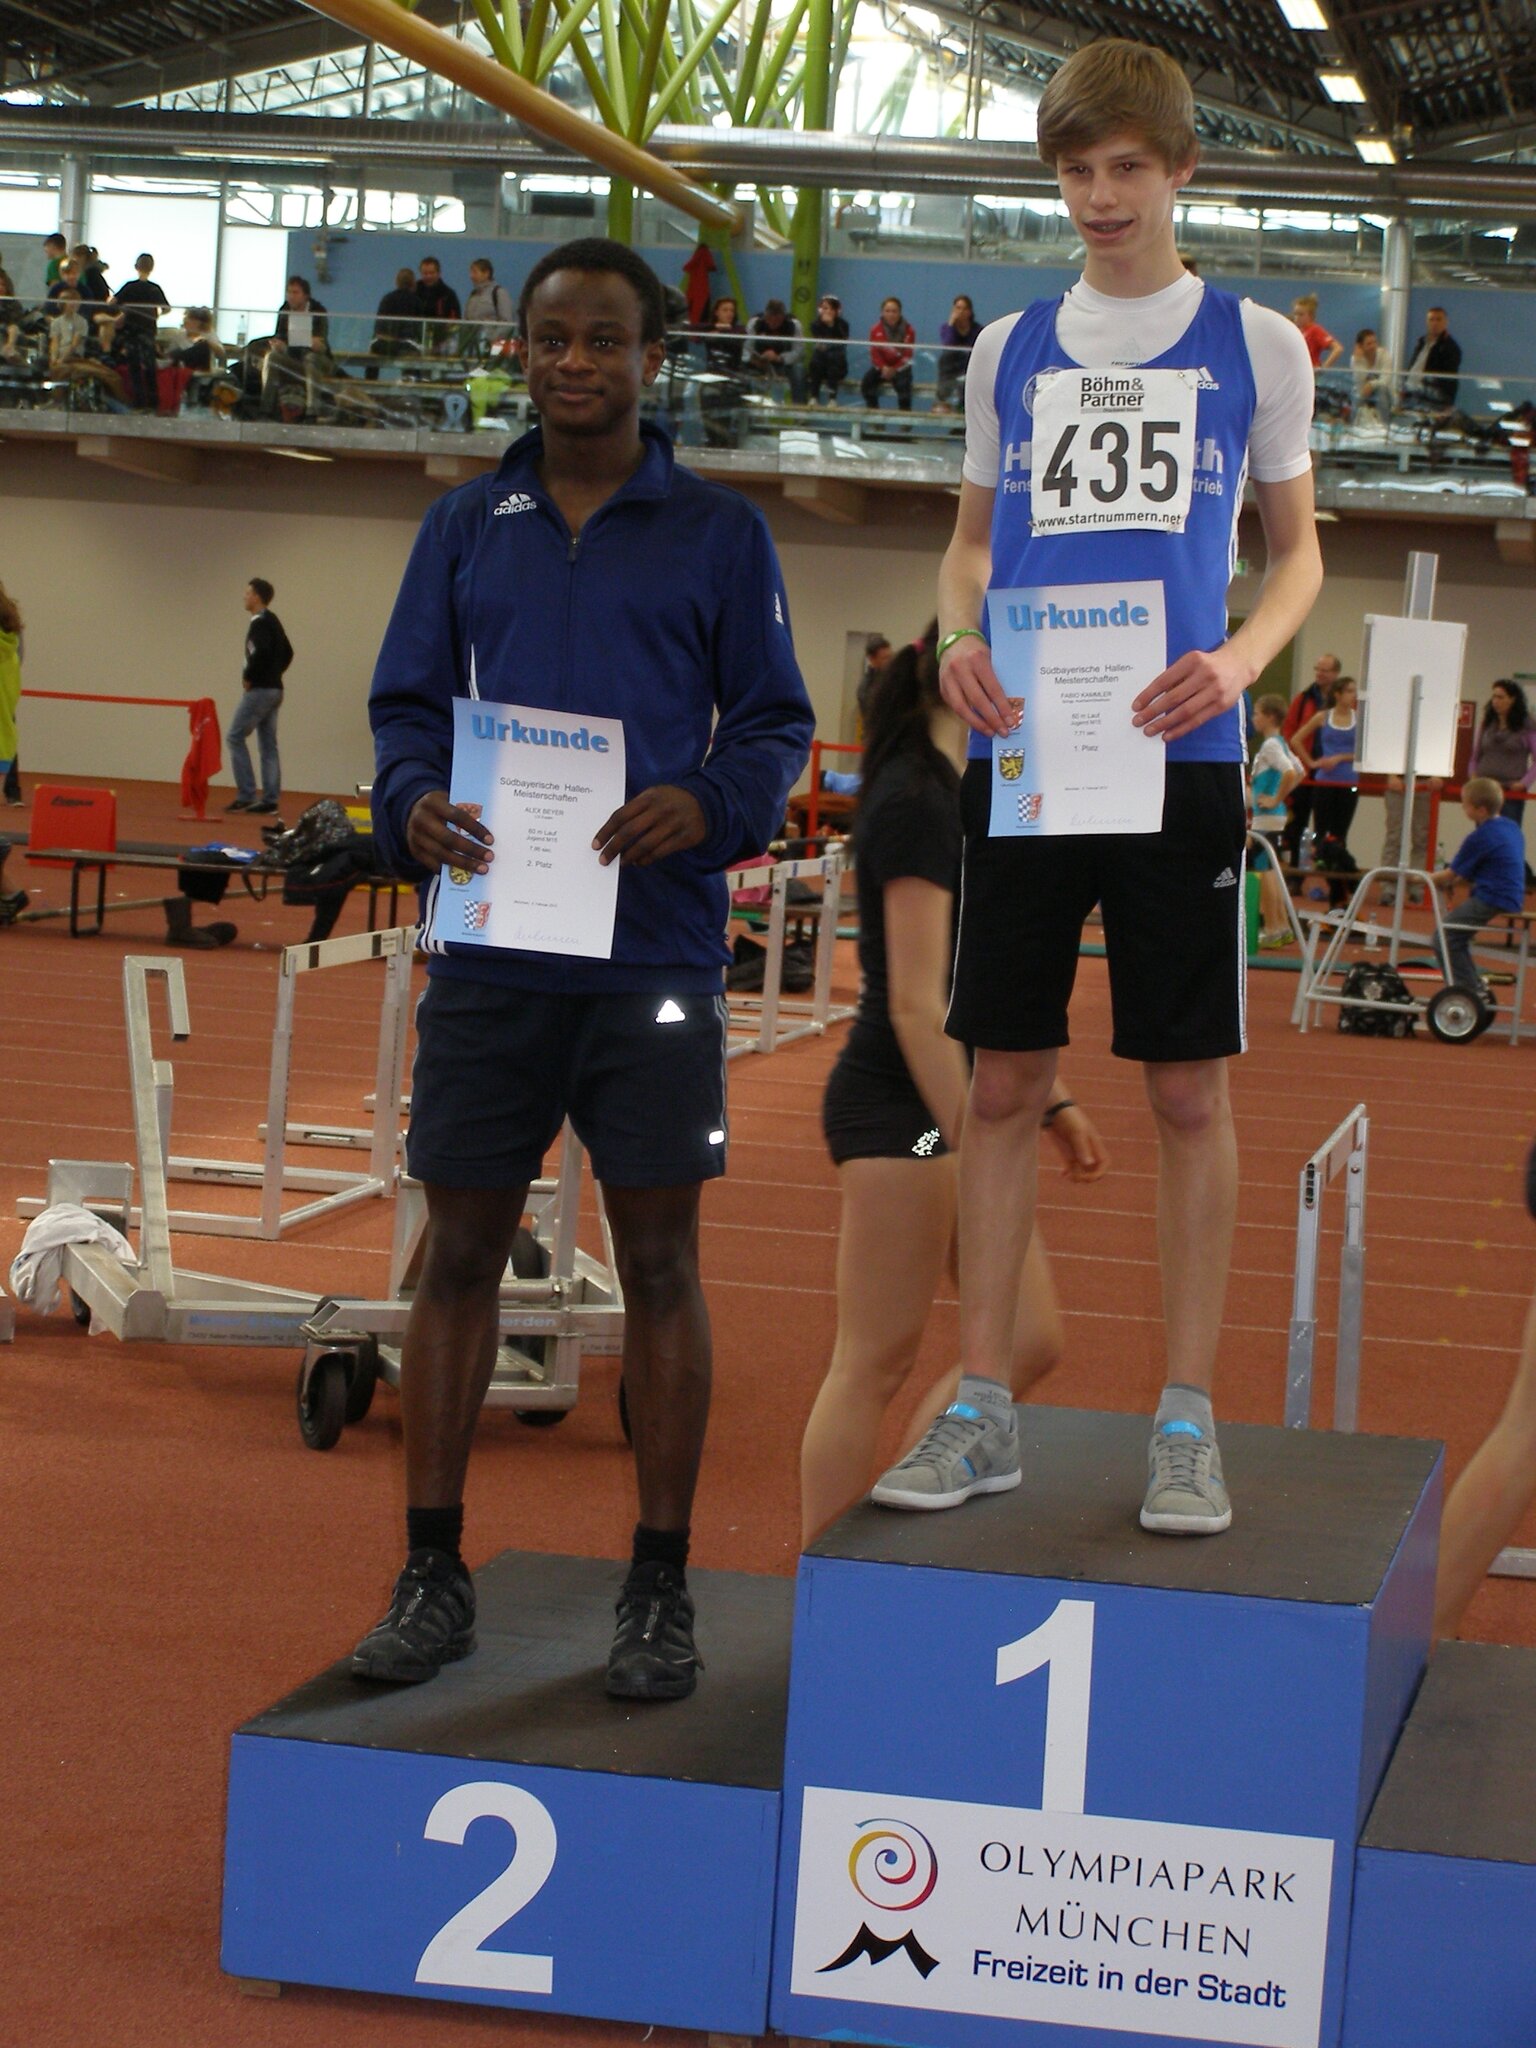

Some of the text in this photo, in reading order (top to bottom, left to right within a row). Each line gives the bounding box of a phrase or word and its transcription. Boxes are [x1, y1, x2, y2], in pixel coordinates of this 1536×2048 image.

[1080, 393, 1145, 408] Partner
[1041, 421, 1181, 508] 435
[493, 501, 537, 516] adidas
[1037, 512, 1182, 529] www.startnummern.net
[1007, 600, 1150, 632] Urkunde
[1039, 663, 1134, 676] Südbayerische Hallen-
[1054, 675, 1119, 685] Meisterschaften
[471, 713, 611, 753] Urkunde
[1081, 744, 1099, 752] Platz
[499, 776, 593, 794] Südbayerische Hallen-
[513, 789, 578, 803] Meisterschaften
[525, 806, 541, 815] ALEX
[535, 860, 553, 869] Platz
[995, 1598, 1096, 1815] 1
[979, 1840, 1298, 1904] OLYMPIAPARK
[414, 1780, 558, 1994] 2
[1015, 1900, 1252, 1958] MÜNCHEN
[972, 1950, 1287, 2009] Freizeit in der Stadt
